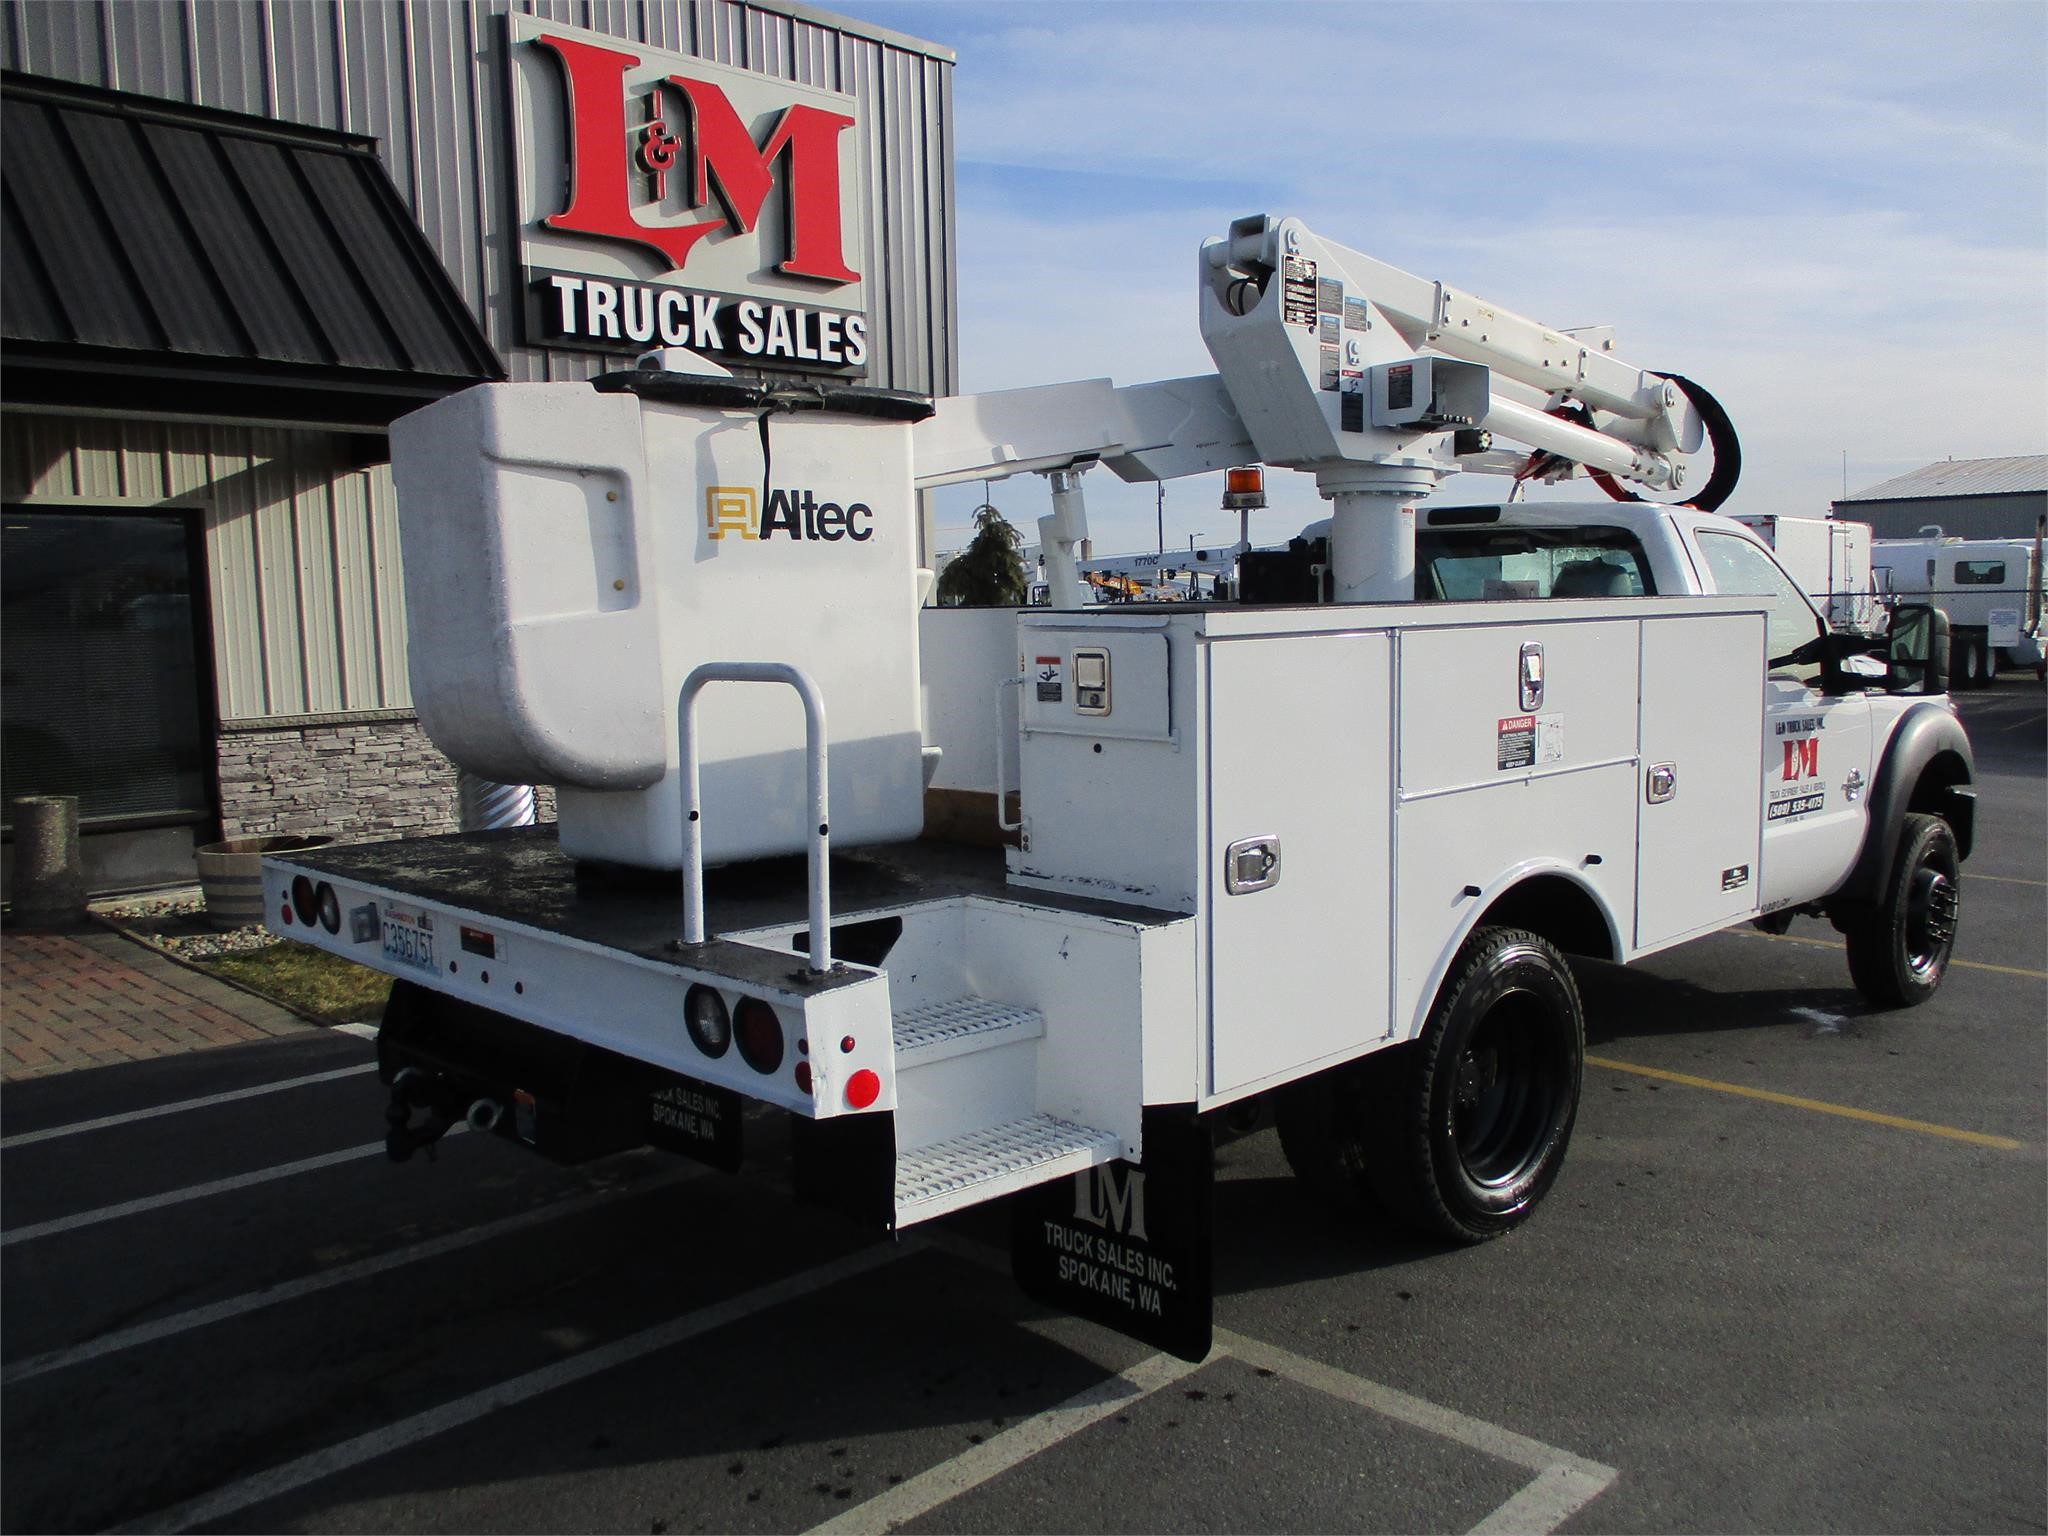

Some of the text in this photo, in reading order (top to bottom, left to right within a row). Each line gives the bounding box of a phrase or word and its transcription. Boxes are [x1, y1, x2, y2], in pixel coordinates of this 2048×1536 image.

[551, 274, 867, 366] TRUCK SALES
[759, 489, 873, 541] Altec
[1508, 718, 1532, 730] DANGER
[1786, 720, 1801, 733] TRUCK
[1802, 718, 1815, 731] SALES
[1769, 801, 1790, 818] (509)
[675, 1087, 704, 1113] SALES
[700, 1119, 715, 1141] WA
[1044, 1221, 1177, 1290] TRUCK SALES INC.
[1058, 1255, 1162, 1316] SPOKANE, WA
